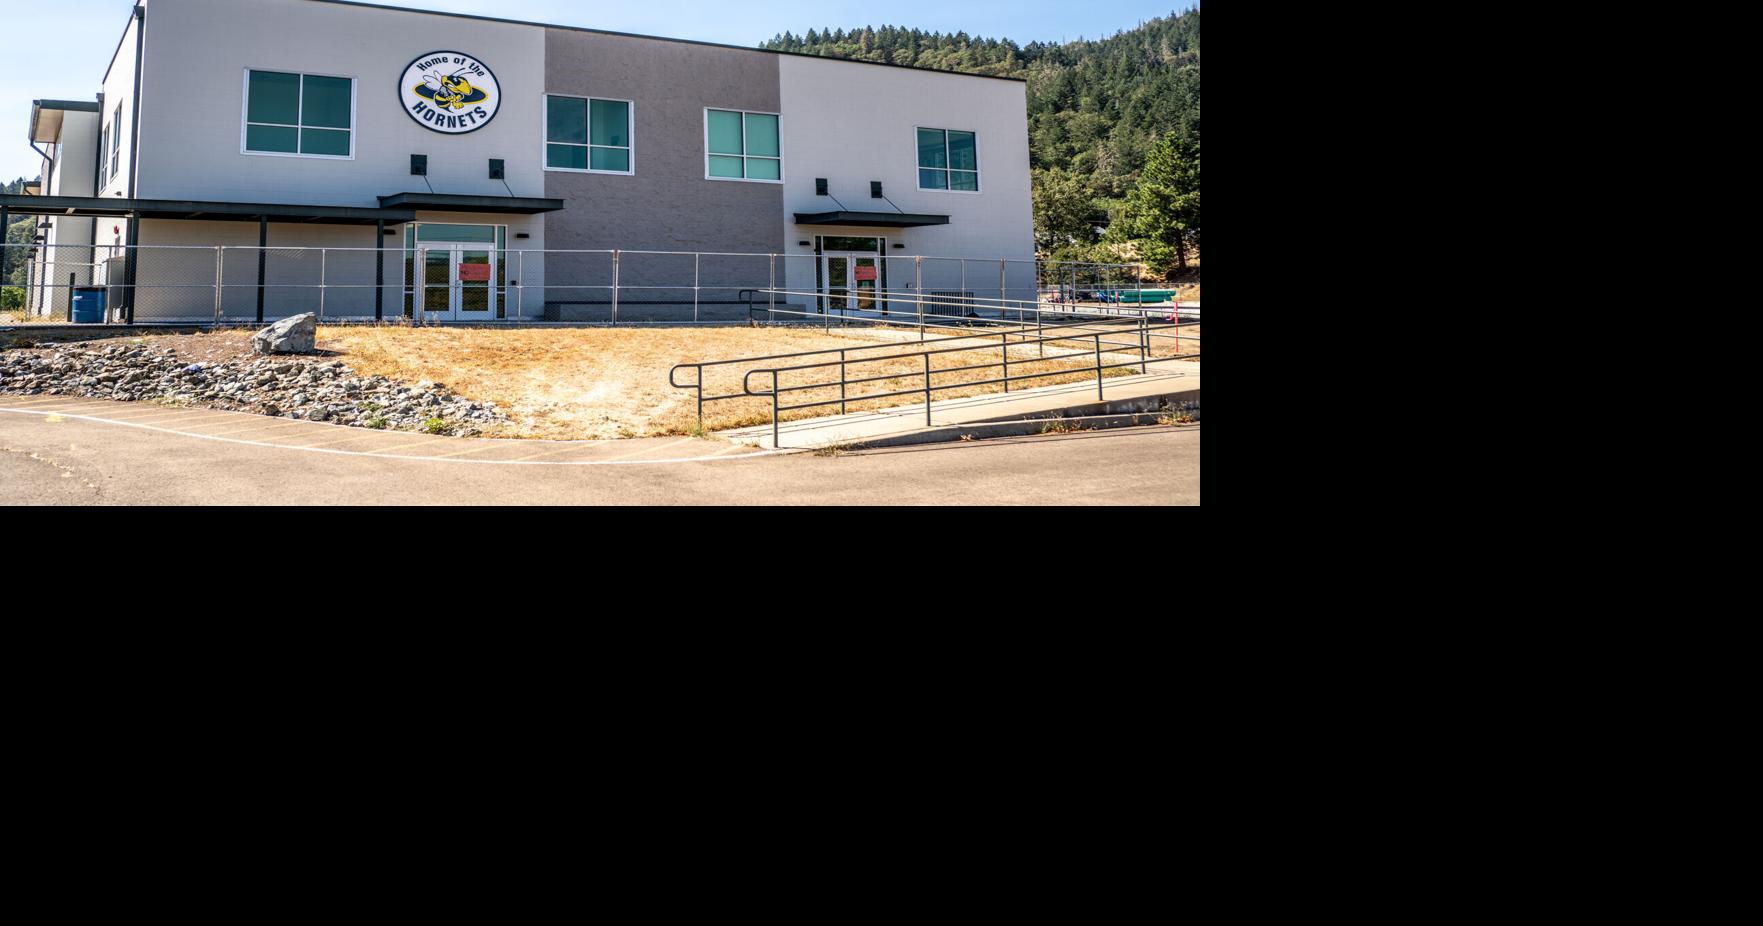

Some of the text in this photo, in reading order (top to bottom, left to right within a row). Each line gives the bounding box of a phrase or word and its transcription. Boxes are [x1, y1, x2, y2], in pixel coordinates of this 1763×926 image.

[416, 56, 485, 77] Home of the
[412, 101, 487, 128] HORNETS
